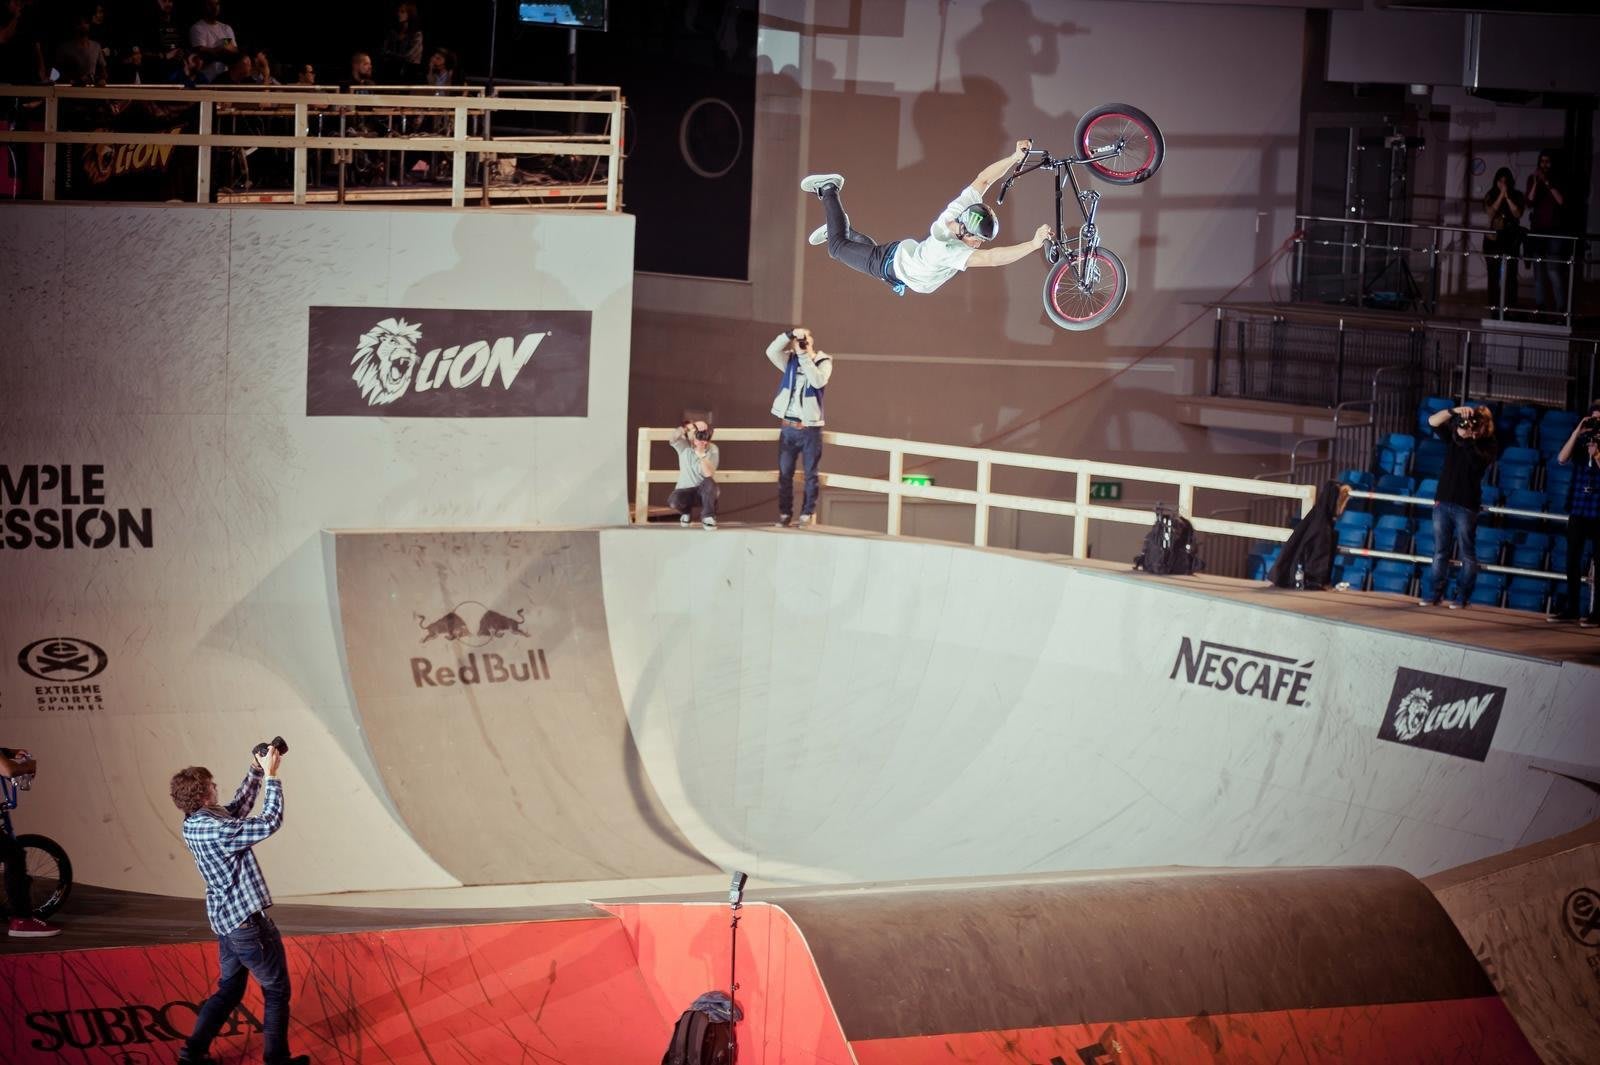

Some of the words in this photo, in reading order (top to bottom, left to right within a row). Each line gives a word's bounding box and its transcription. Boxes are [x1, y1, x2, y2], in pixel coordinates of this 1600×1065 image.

[0, 508, 154, 550] SSION
[410, 652, 480, 688] Red
[482, 649, 551, 683] Bull
[1169, 636, 1316, 707] NESCAFÉ
[35, 685, 101, 695] EXTREME
[37, 695, 103, 704] SPORTS
[38, 704, 104, 712] CHANNEL
[26, 1000, 264, 1051] SUBROA
